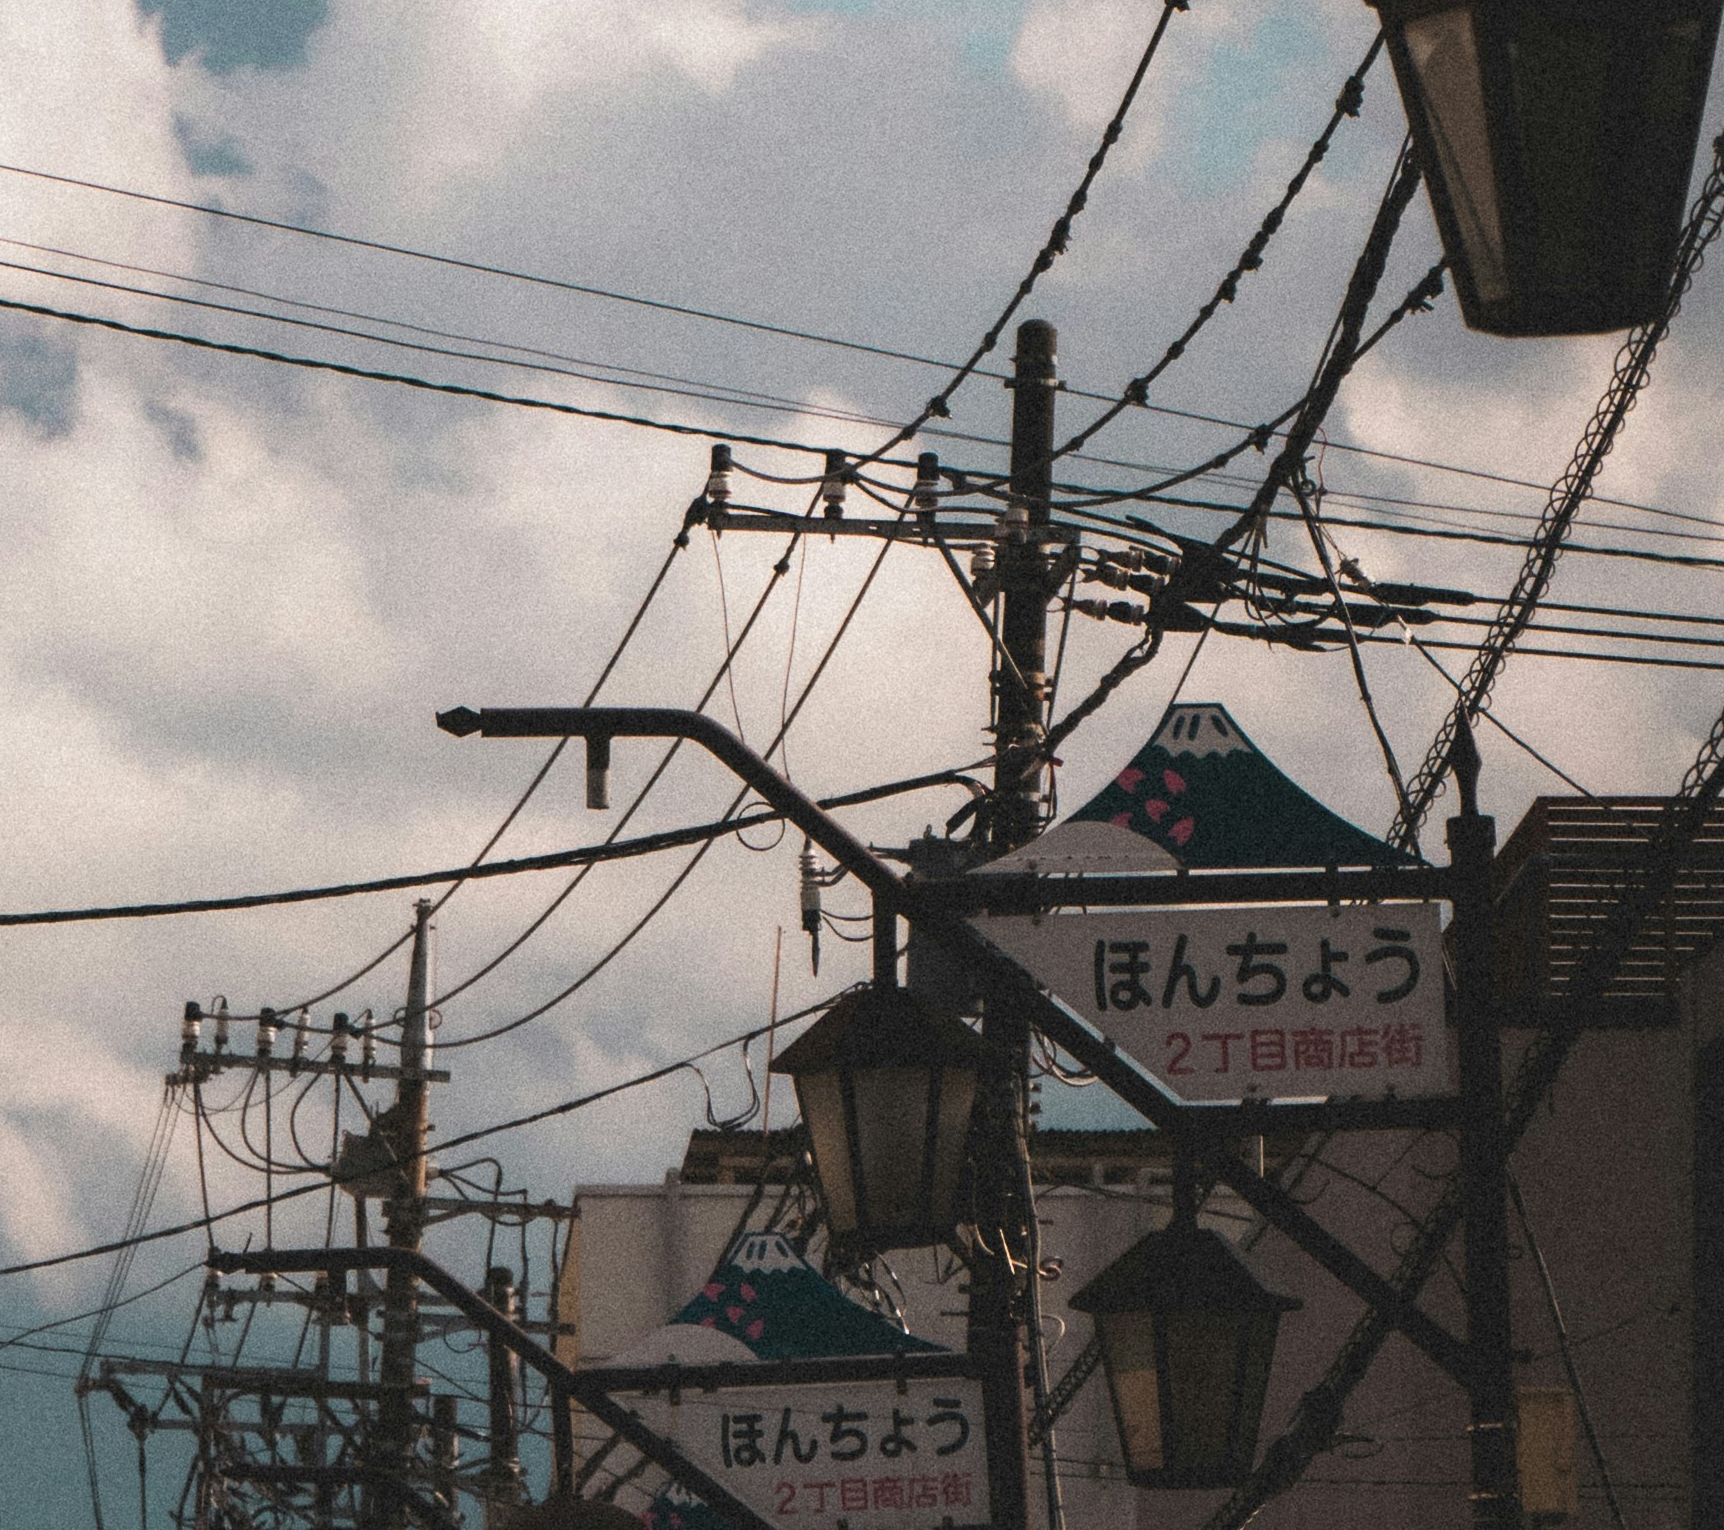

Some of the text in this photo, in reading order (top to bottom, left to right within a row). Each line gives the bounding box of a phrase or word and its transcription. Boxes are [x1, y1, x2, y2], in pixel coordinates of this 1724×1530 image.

[1093, 927, 1420, 1012] ほんちょう
[1165, 1024, 1423, 1076] 2丁目商店街
[722, 1398, 970, 1469] ほんちょう
[774, 1472, 972, 1516] 2丁目商店街
